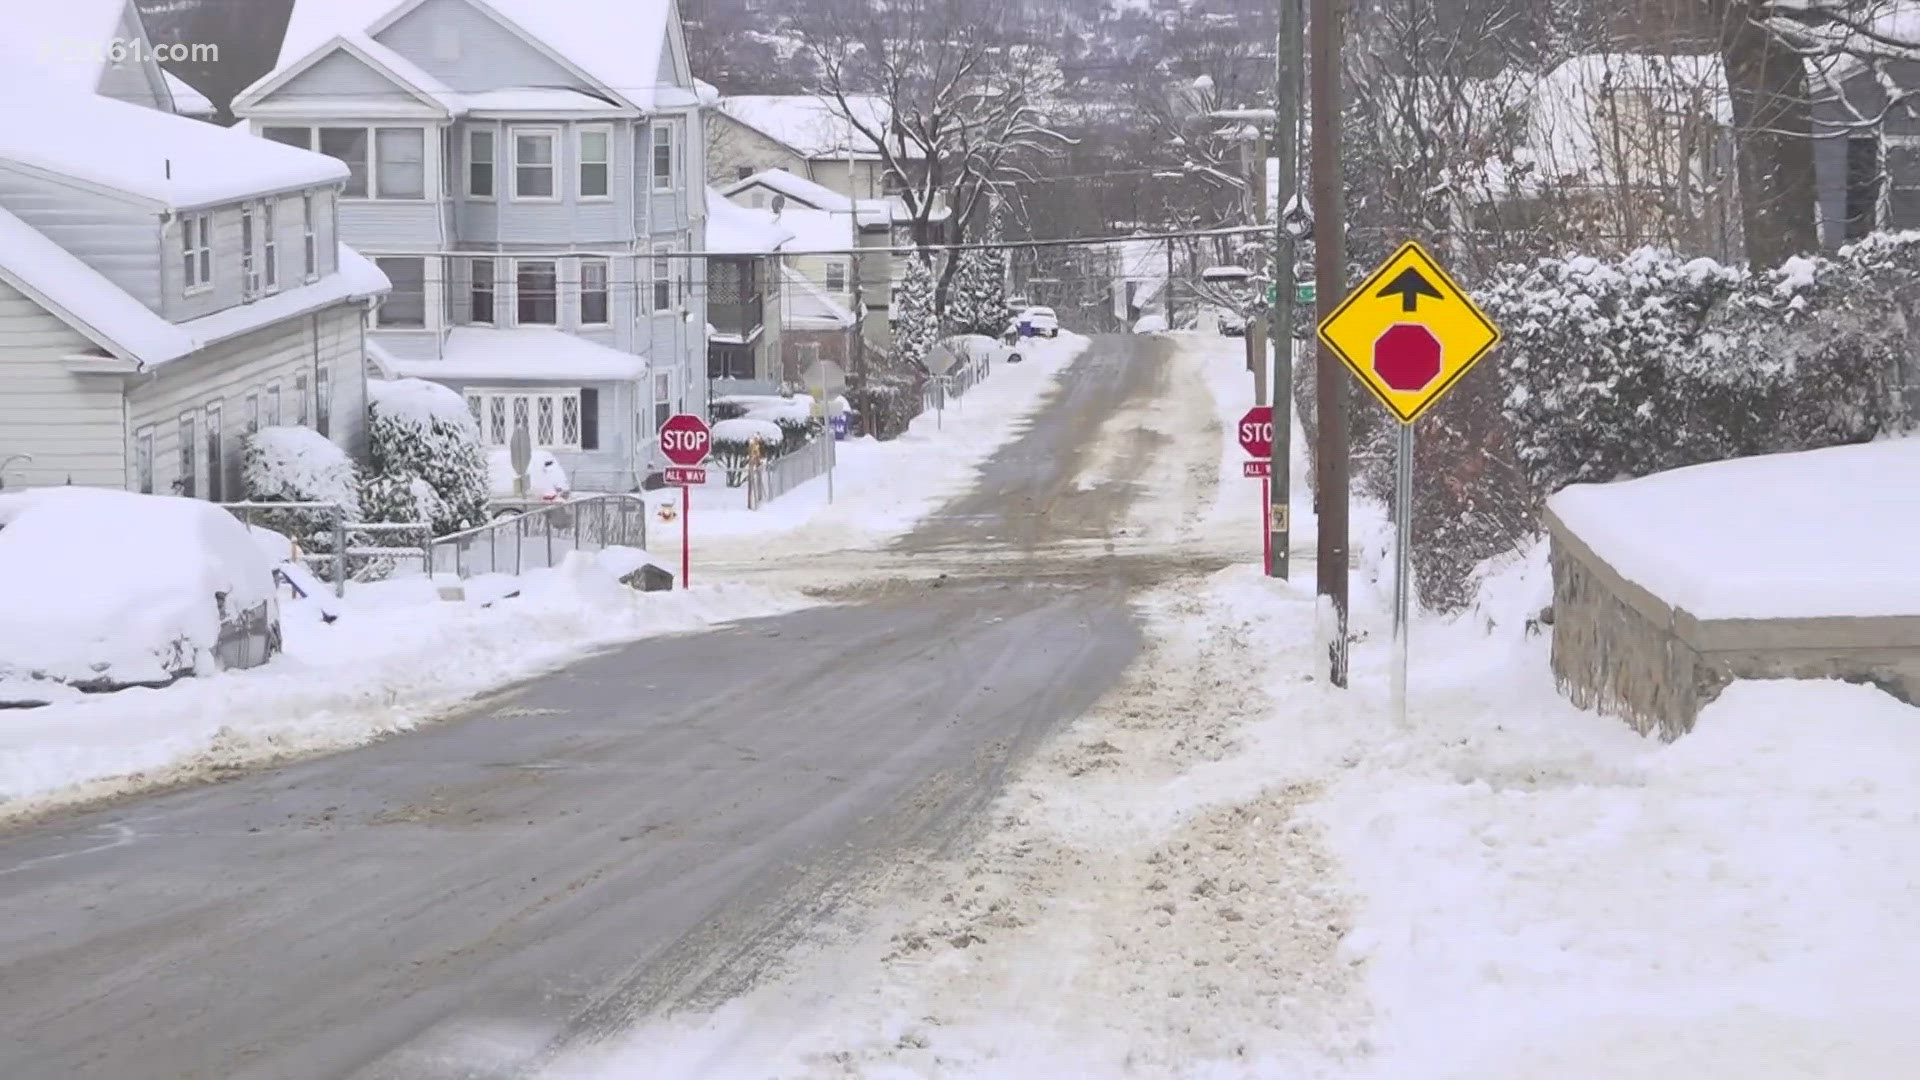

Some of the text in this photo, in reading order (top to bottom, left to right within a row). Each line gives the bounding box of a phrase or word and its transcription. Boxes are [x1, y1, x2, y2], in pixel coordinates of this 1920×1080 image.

[663, 430, 707, 451] STOP
[1241, 423, 1273, 443] STO
[666, 470, 705, 482] ALL WAY
[1245, 464, 1261, 474] ALL
